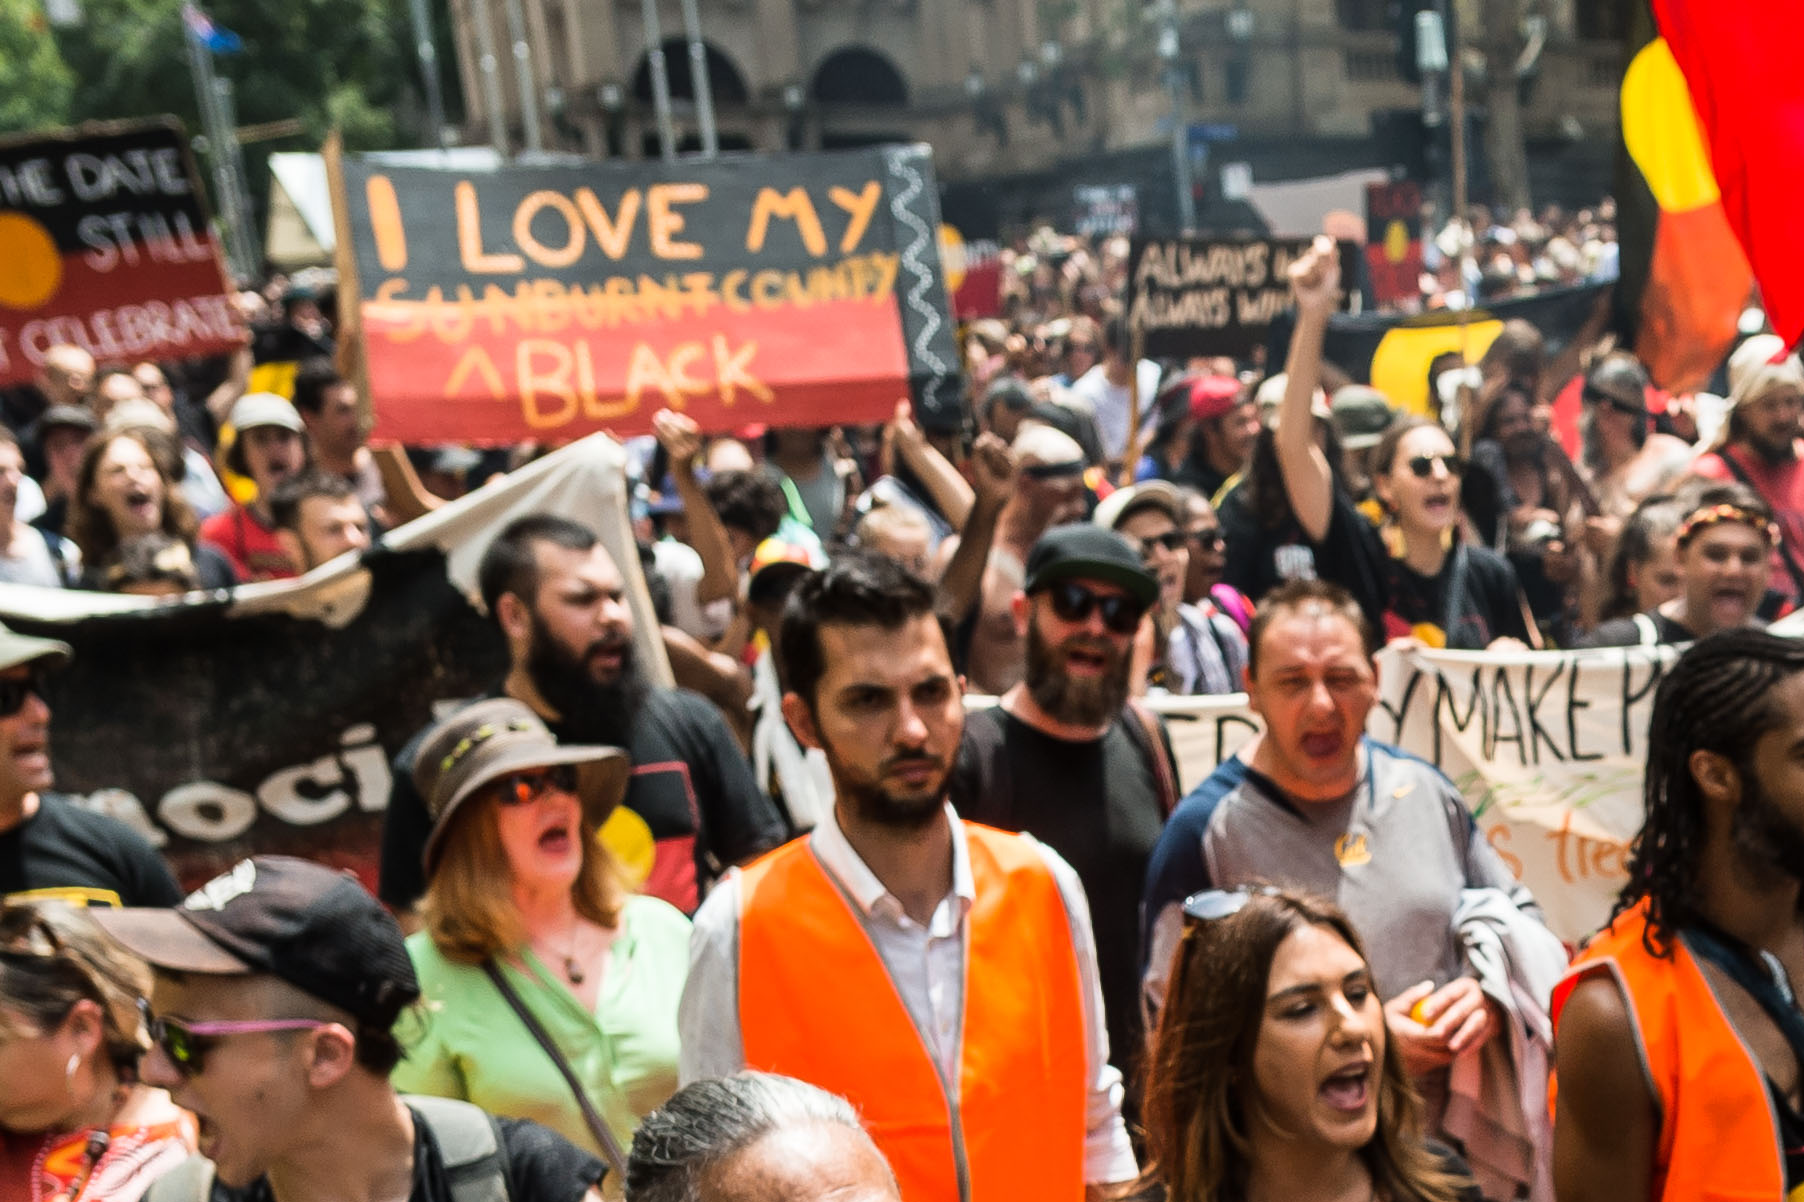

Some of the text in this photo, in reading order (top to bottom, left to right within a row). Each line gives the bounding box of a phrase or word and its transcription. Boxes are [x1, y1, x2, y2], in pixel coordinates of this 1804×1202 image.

[65, 147, 190, 201] DATE
[77, 209, 213, 273] STILL
[366, 174, 882, 275] I LOVE MY
[1135, 242, 1268, 288] ALWAYS
[19, 294, 252, 367] CELEBRATE
[516, 335, 774, 429] BLACK
[1434, 657, 1604, 767] MAKE
